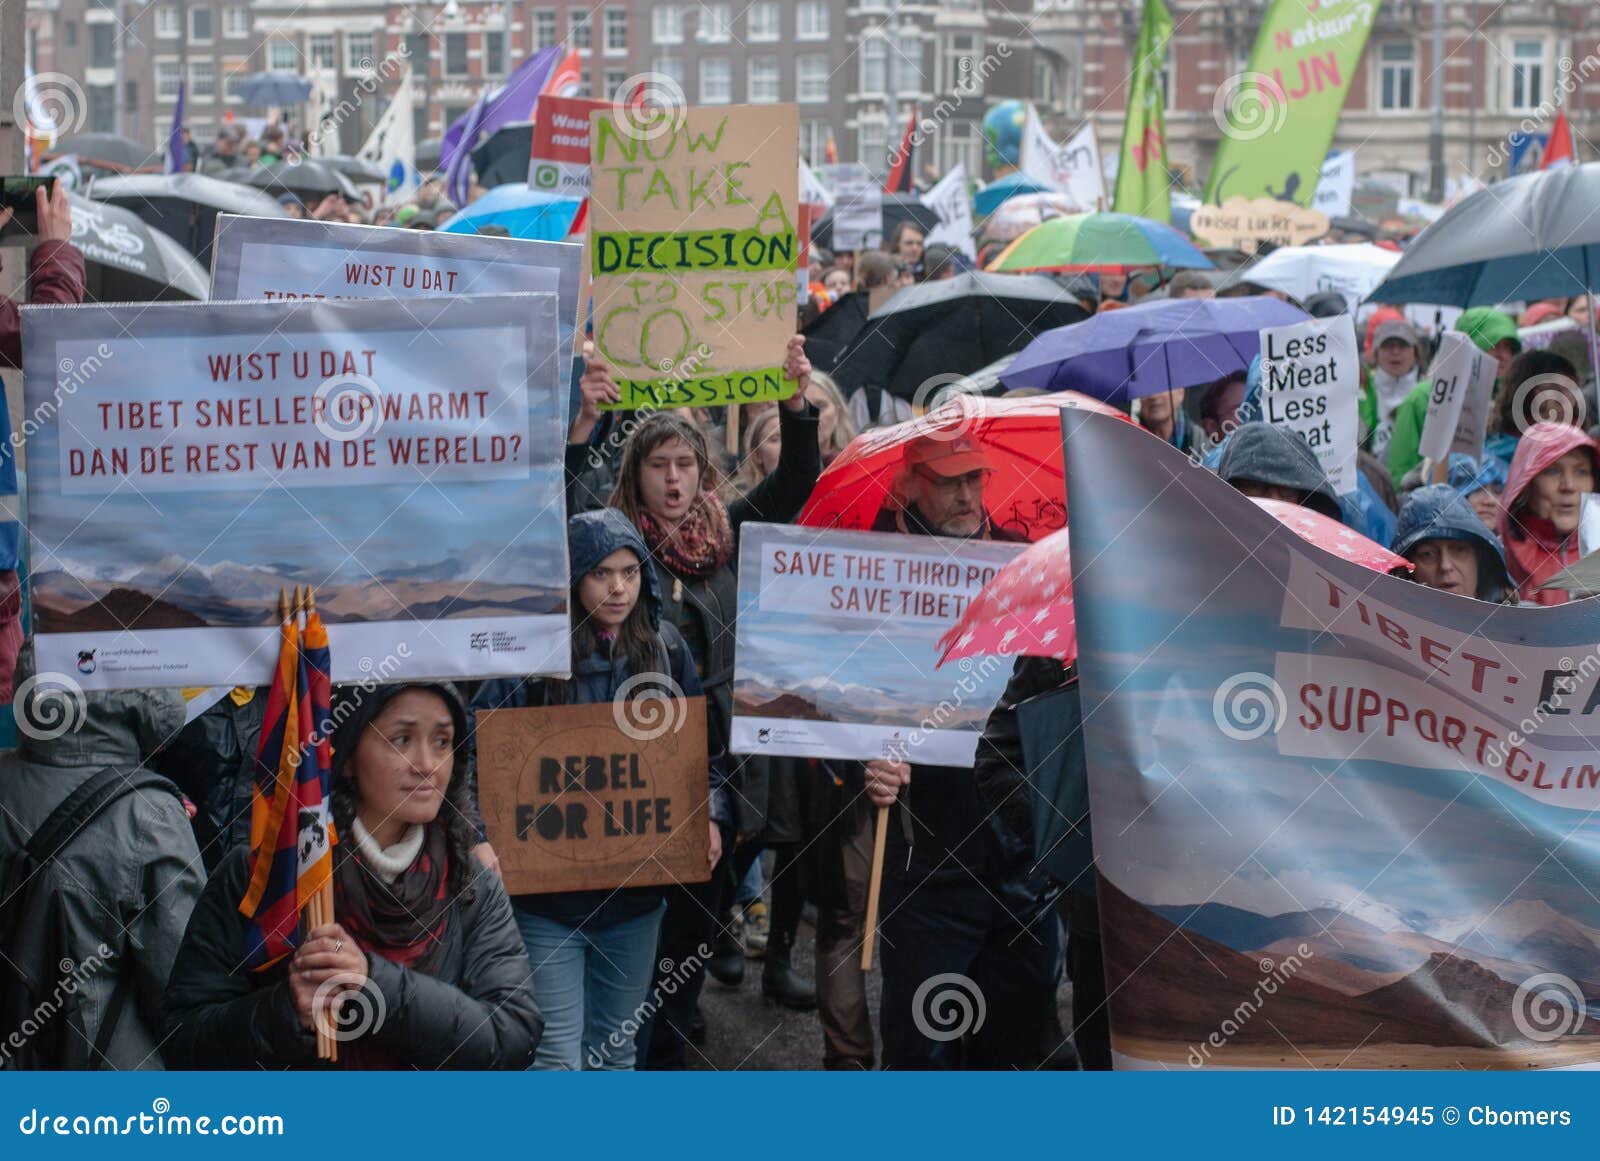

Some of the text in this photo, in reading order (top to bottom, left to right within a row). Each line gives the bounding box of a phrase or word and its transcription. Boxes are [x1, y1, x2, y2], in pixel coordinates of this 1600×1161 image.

[598, 114, 729, 164] NOW
[601, 162, 752, 212] TAKE
[755, 191, 794, 236] A
[597, 233, 792, 272] DECISION
[345, 263, 458, 292] WIST U DAT
[703, 280, 797, 321] STOP
[208, 350, 376, 382] WIST U DAT
[1267, 333, 1327, 361] Less
[612, 373, 780, 405] MISSION
[1269, 357, 1337, 391] Meat
[97, 391, 489, 431] TIBET SNELLER OPWARMT
[1268, 395, 1327, 424] Less
[69, 435, 522, 477] DAN DE REST VAN DE WERELD?
[773, 549, 1001, 590] SAVE THE THIRD PO
[830, 585, 892, 614] SAVE
[1316, 571, 1518, 704] TIBET:
[1299, 682, 1498, 766] SUPPORT
[539, 753, 647, 794] REBEL
[515, 797, 672, 842] FOR LIFE
